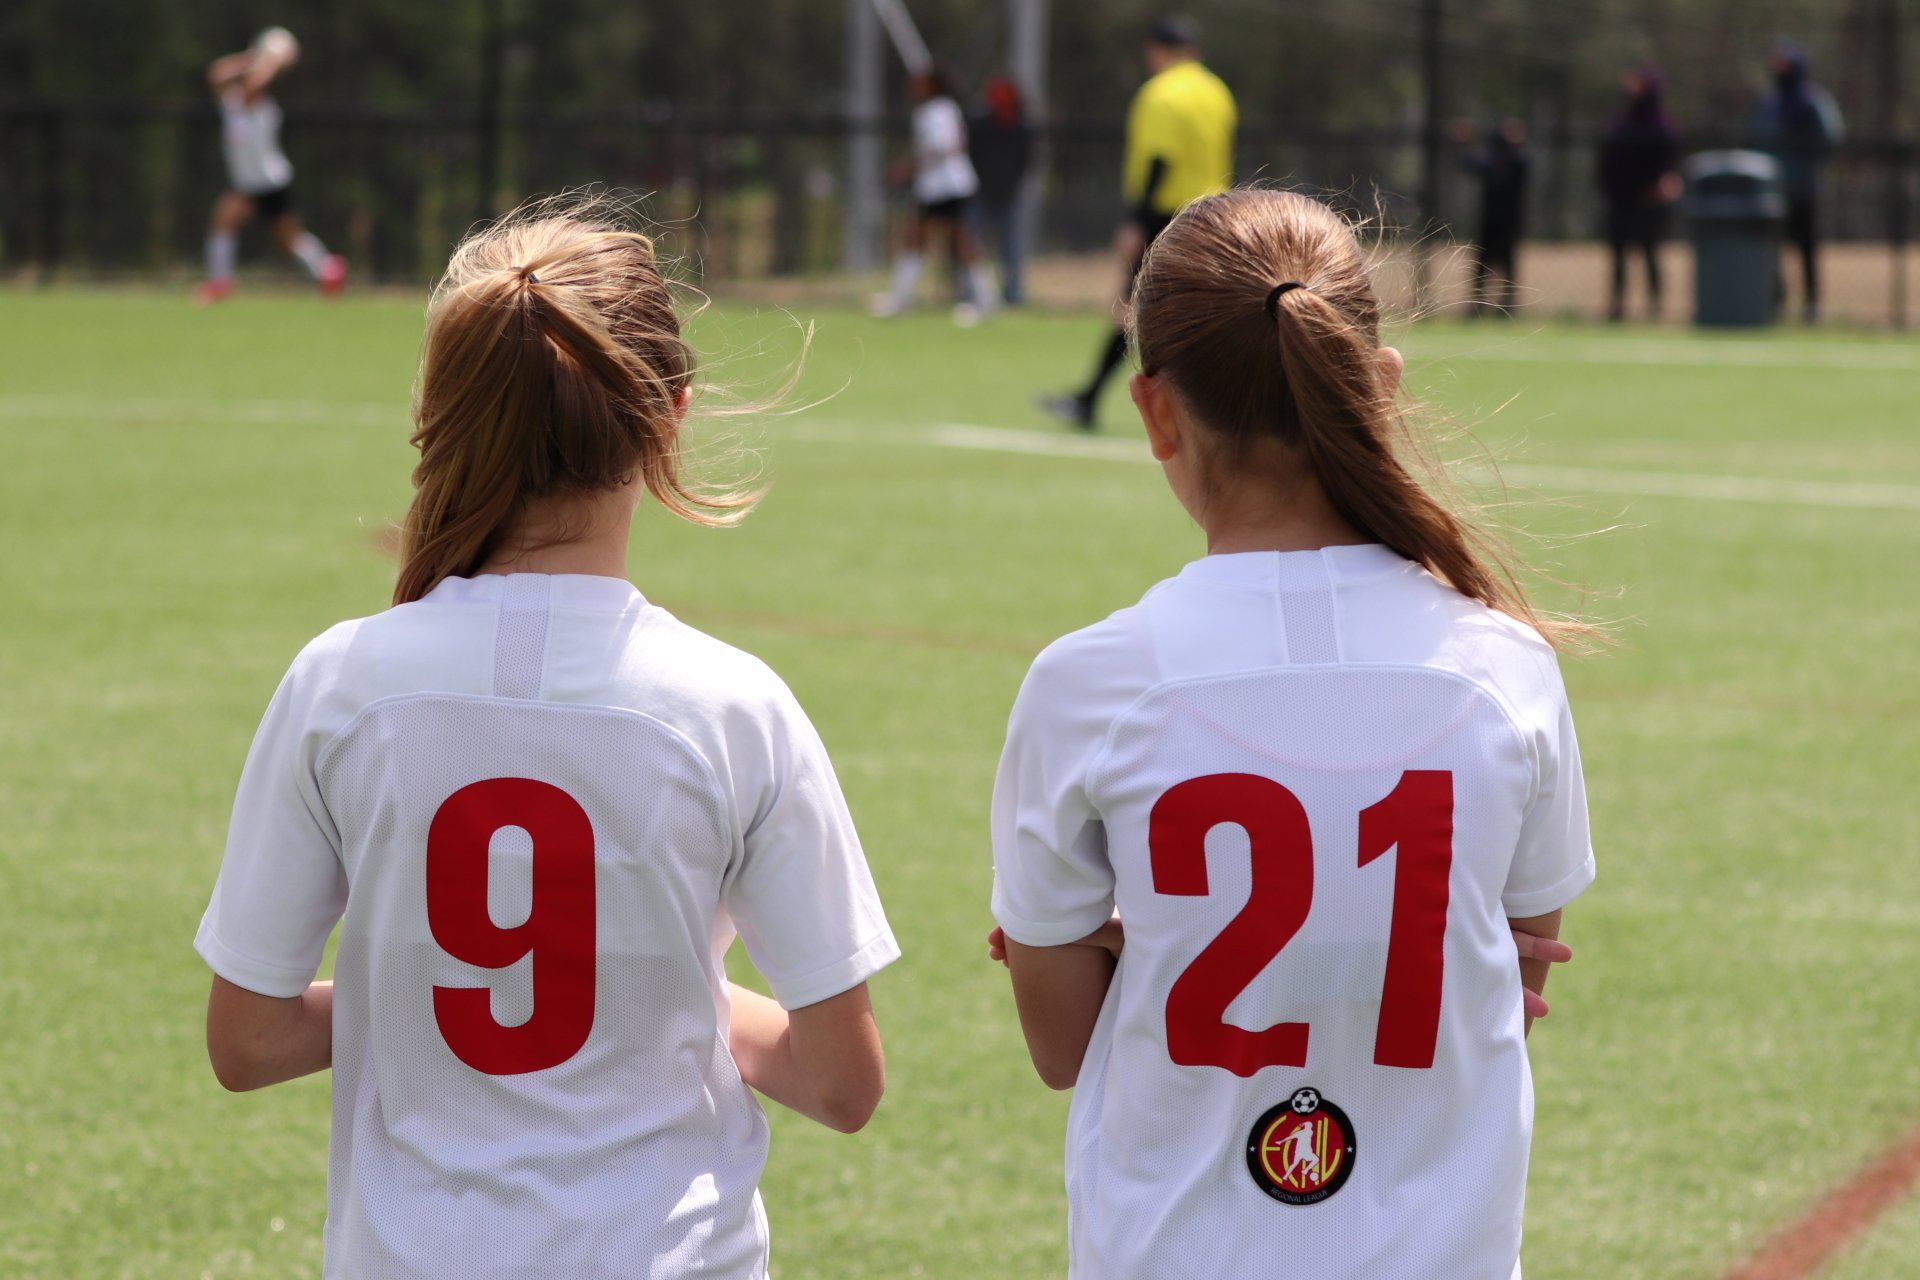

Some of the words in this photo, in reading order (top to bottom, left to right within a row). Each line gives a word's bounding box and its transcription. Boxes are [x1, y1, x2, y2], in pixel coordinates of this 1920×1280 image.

[426, 777, 596, 1076] 9
[1148, 770, 1454, 1078] 21
[1303, 1189, 1328, 1202] LEAGUE
